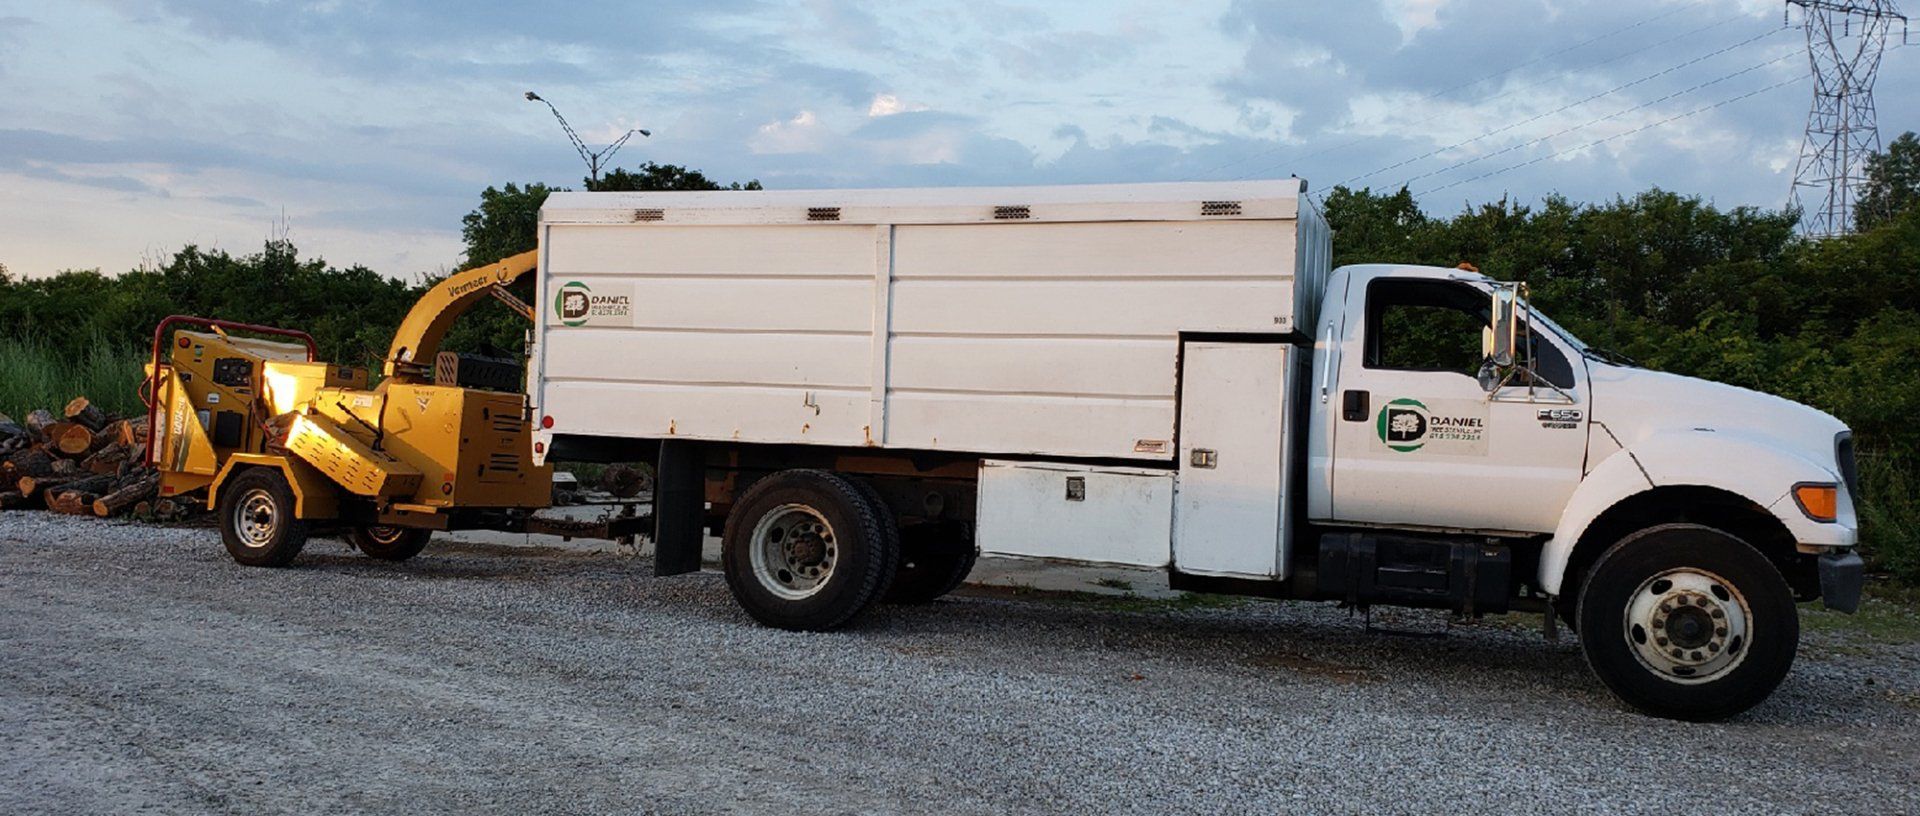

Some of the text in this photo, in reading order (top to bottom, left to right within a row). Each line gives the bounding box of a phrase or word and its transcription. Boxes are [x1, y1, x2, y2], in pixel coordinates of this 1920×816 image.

[448, 275, 488, 297] Vermeer
[591, 296, 630, 305] DANIEL
[1430, 416, 1484, 427] DANIEL
